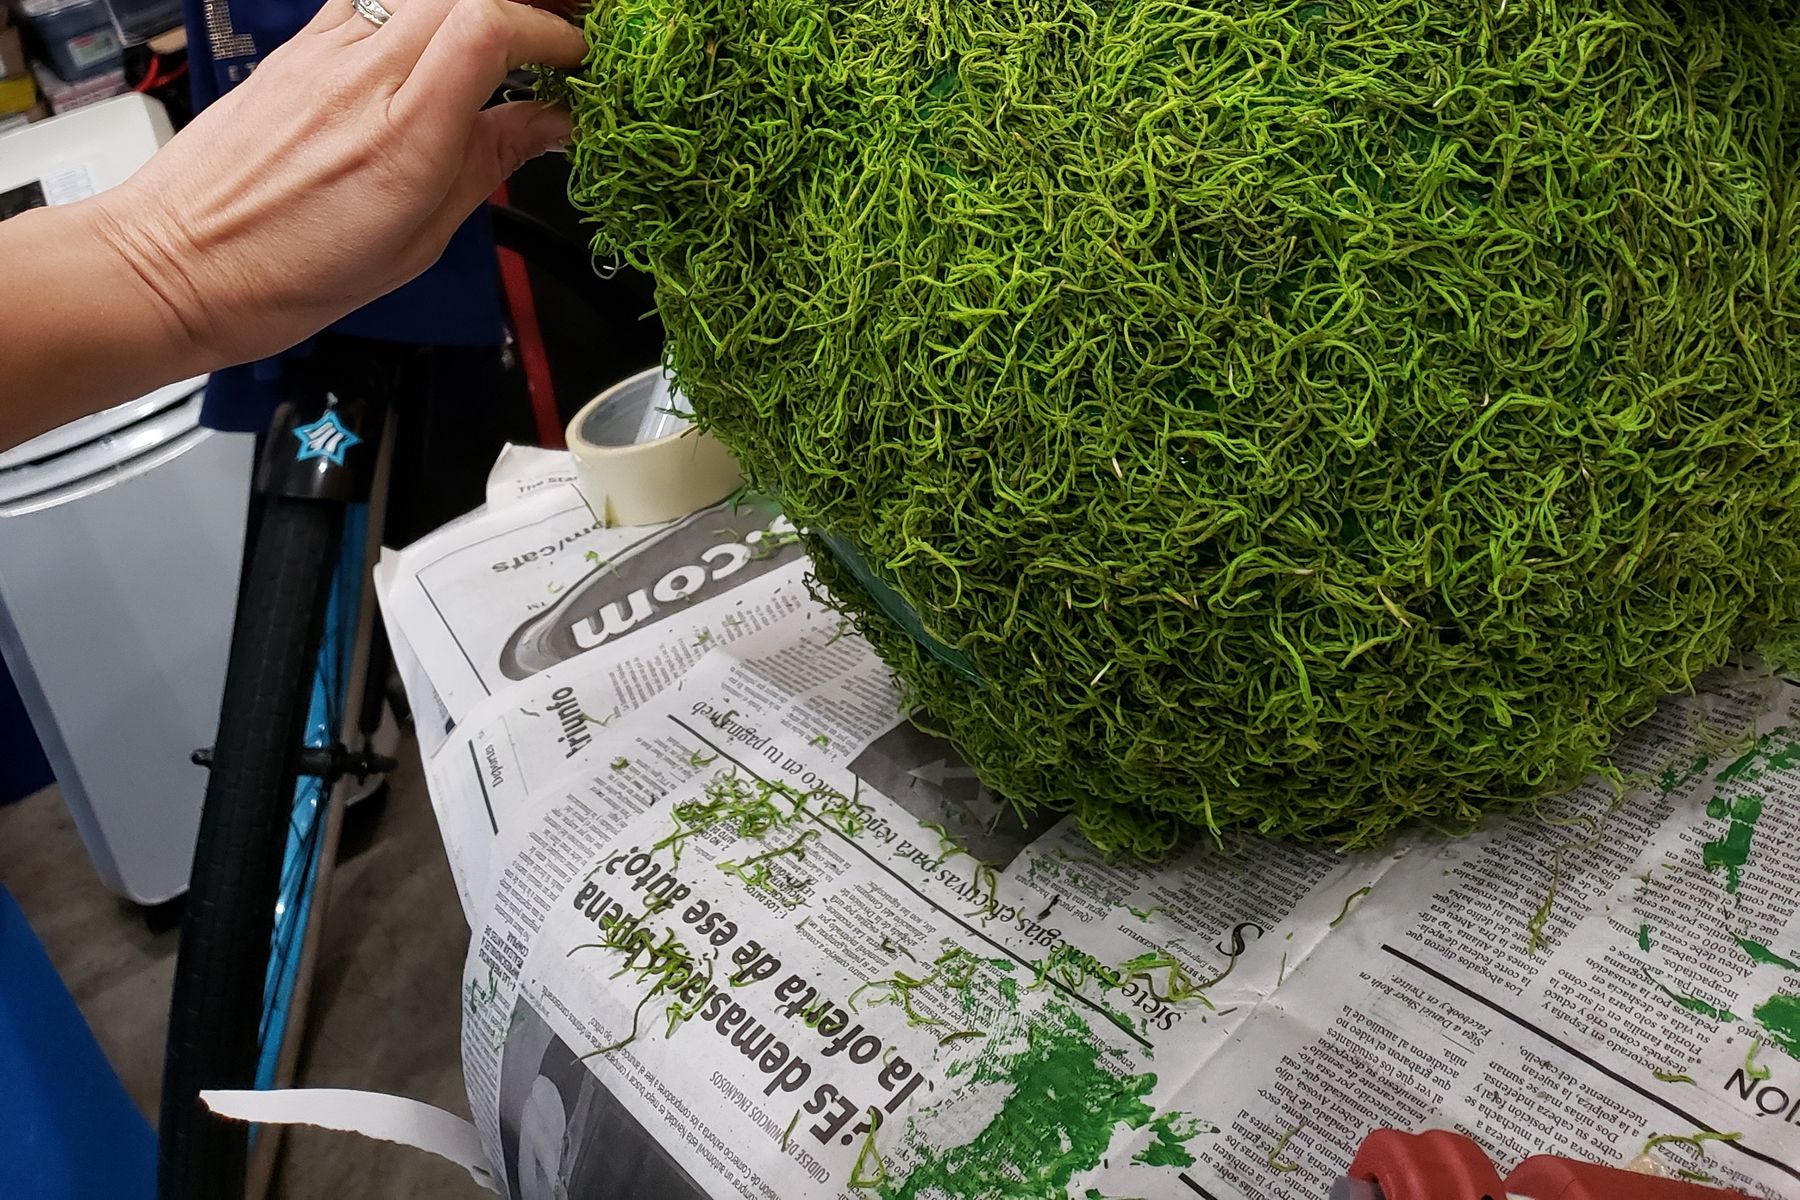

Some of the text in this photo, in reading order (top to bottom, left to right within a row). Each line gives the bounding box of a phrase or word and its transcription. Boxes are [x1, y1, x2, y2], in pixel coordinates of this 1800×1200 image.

[546, 686, 591, 758] triunfo
[717, 711, 770, 750] pagina
[763, 744, 784, 764] tu
[780, 757, 803, 774] en
[895, 839, 941, 872] para
[1512, 856, 1553, 882] Fridman,
[742, 881, 780, 912] LOS DATOS
[1050, 882, 1072, 899] buena
[1746, 871, 1793, 894] Broward
[1071, 894, 1086, 906] una
[1085, 902, 1108, 920] lograr
[1186, 913, 1221, 935] efectivas
[816, 913, 889, 967] automóvil motivado por
[1659, 929, 1752, 978] Abreu debe cerca
[822, 947, 849, 967] consejos
[1405, 929, 1523, 996] Los abogados dijeron que
[1416, 923, 1531, 987] la corte federal de apela-
[605, 846, 924, 1113] la oferta de ese auto?
[847, 965, 869, 982] cuatro
[1358, 971, 1371, 980] en
[1370, 978, 1394, 995] Roth
[1390, 974, 1425, 999] Twitter.
[1662, 957, 1738, 1001] incapacitados.
[1121, 979, 1181, 1030] Siete
[1392, 991, 1420, 1009] Shoer
[1425, 994, 1439, 1004] en
[1543, 989, 1576, 1009] educó
[1557, 968, 1702, 1055] Florida, solo para ver cómo
[1418, 1005, 1453, 1028] Daniel
[1446, 1005, 1492, 1036] Facebook
[1550, 1006, 1589, 1034] España
[1585, 1013, 1608, 1028] crió
[1342, 1004, 1459, 1078] acudieron al auxilio de la
[1461, 1029, 1484, 1046] Siga
[1590, 1029, 1605, 1041] en
[1609, 1026, 1640, 1046] cómo
[1297, 1051, 1315, 1066] vio-
[1326, 1027, 1443, 1104] al ver que los estudiantes
[1335, 1016, 1451, 1090] que grabaron el video no
[1443, 1047, 1467, 1067] niña.
[1641, 1045, 1687, 1076] después
[1315, 1062, 1335, 1078] esta
[1334, 1076, 1356, 1089] por
[628, 1074, 646, 1095] buscar
[709, 1070, 752, 1112] ENGAÑOSOS
[1274, 1066, 1364, 1129] Robert Avossa, dijo
[1279, 1054, 1378, 1120] comunicado que está
[1480, 1088, 1507, 1109] fetal
[1519, 1045, 1647, 1127] fuertemente del cabello,
[656, 1082, 691, 1118] compradores
[1274, 1081, 1356, 1140] Condado de Palm
[663, 1109, 687, 1138] Navidad,
[688, 1114, 699, 1129] los
[748, 1106, 791, 1144] ANUNCIOS
[792, 1084, 883, 1148] ¿Es
[1257, 1088, 1359, 1156] superintendente esco-
[1482, 1071, 1622, 1160] cubre su cabeza indefensa.
[1507, 1104, 1554, 1135] posición
[685, 1131, 698, 1147] esta
[701, 1126, 724, 1151] exhorta
[1553, 1131, 1568, 1144] en
[723, 1147, 751, 1179] Comercio
[794, 1148, 830, 1183] CUÍDESE
[1199, 1151, 1239, 1183] sobre su
[1212, 1142, 1254, 1176] embisten
[1224, 1134, 1283, 1176] mientras los
[723, 1168, 734, 1181] un
[750, 1172, 761, 1186] de
[1251, 1172, 1266, 1186] la
